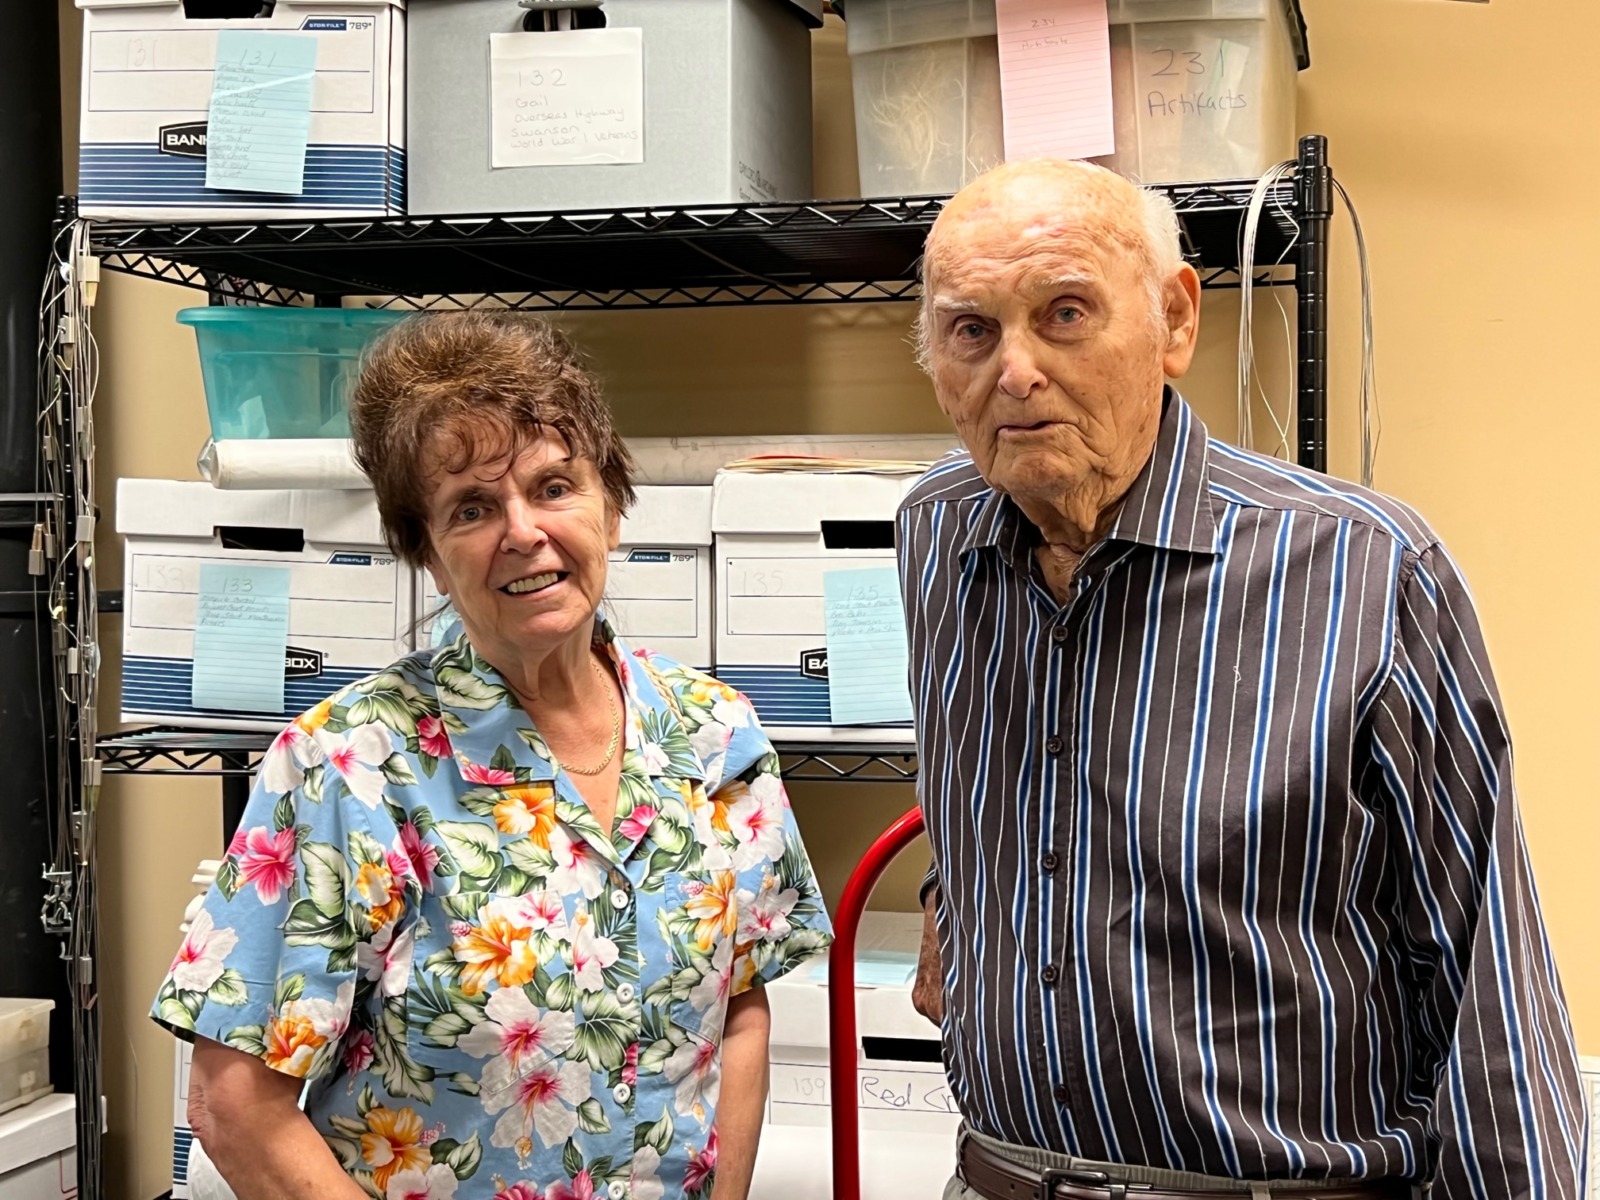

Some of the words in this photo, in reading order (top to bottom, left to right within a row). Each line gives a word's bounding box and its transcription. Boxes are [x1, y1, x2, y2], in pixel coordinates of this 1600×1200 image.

[125, 38, 157, 69] 131
[238, 48, 278, 69] 131
[1151, 39, 1225, 77] 231
[518, 68, 568, 88] 132
[515, 95, 549, 109] Gail
[1147, 89, 1248, 118] Artifacts
[511, 125, 580, 138] Swanson
[222, 577, 254, 594] 133
[743, 569, 785, 595] 135
[847, 584, 880, 602] 135
[861, 1076, 912, 1107] Red
